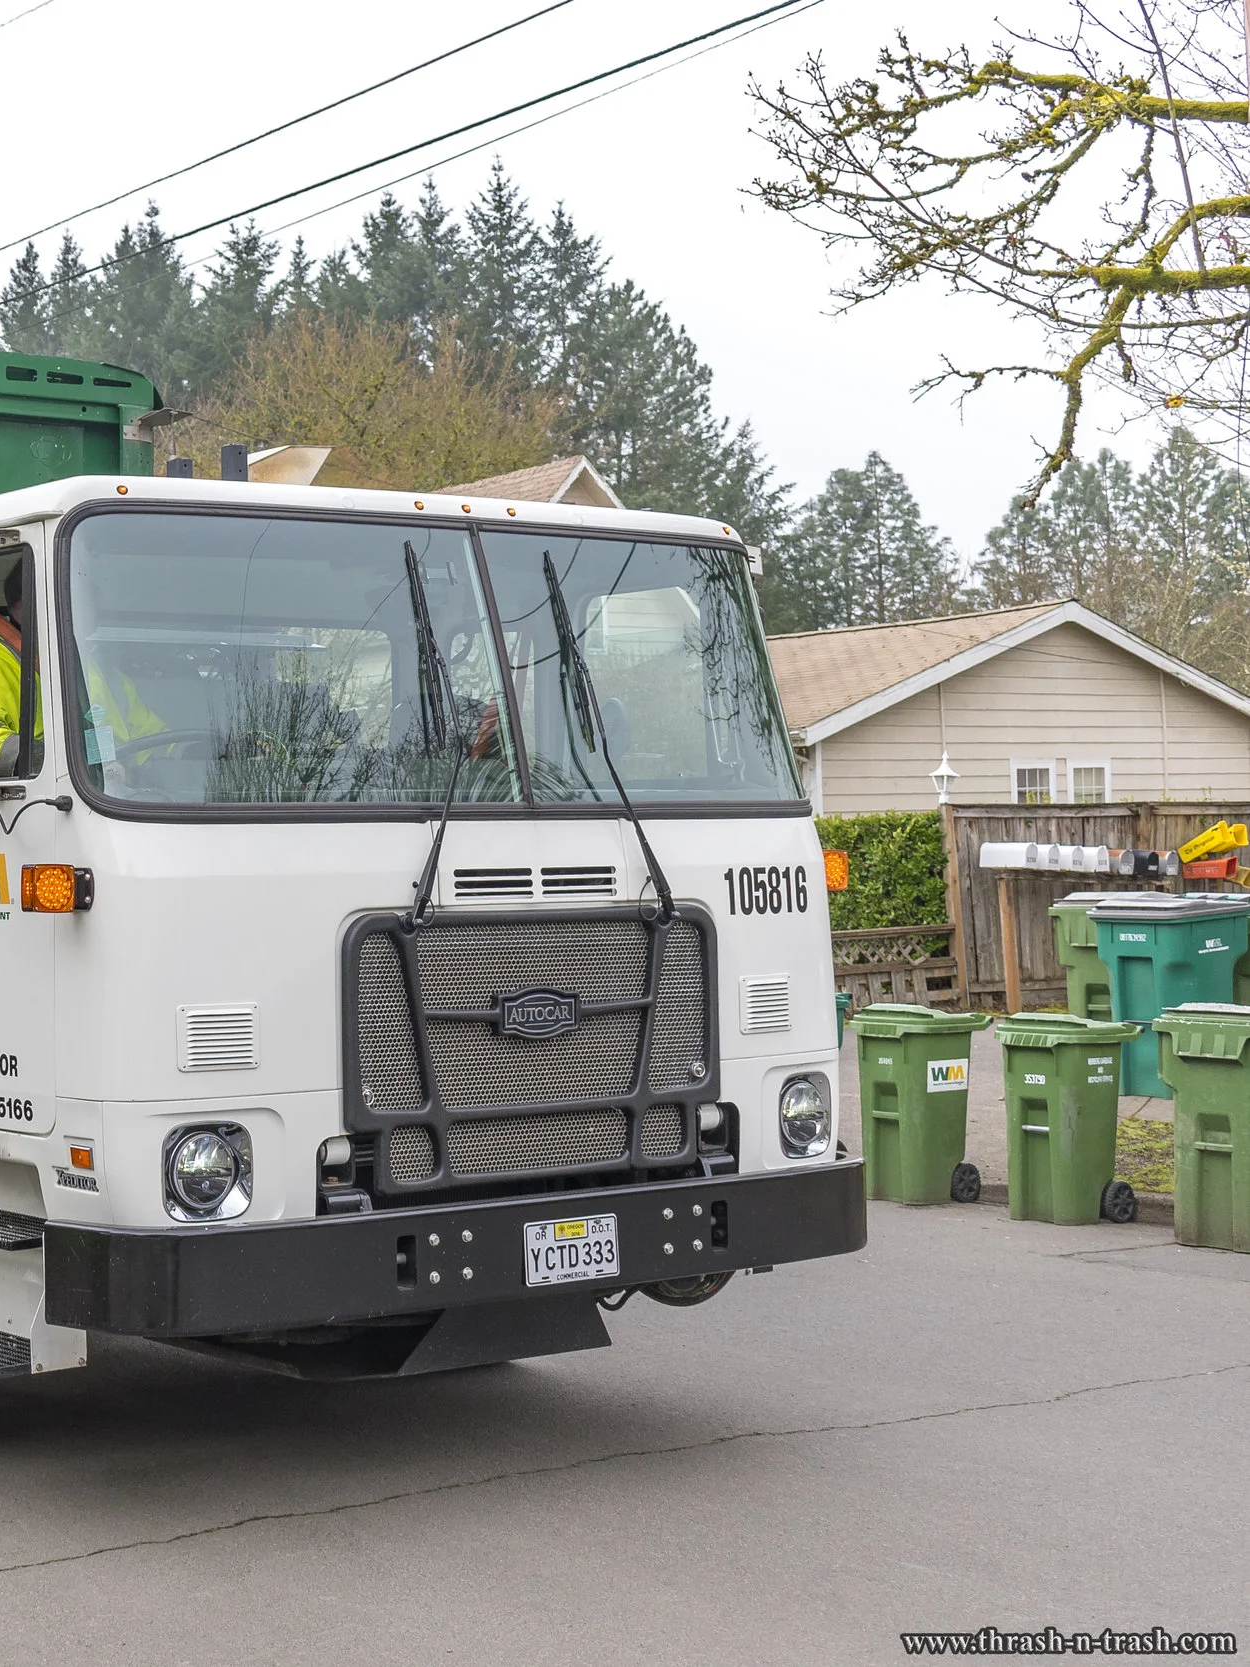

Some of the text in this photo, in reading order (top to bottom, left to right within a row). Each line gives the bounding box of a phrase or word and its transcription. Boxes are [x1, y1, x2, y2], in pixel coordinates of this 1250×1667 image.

[724, 865, 808, 915] 105816
[508, 1005, 571, 1022] AUTOCAR
[0, 1053, 18, 1077] OR
[931, 1065, 965, 1081] WM
[1024, 1073, 1046, 1085] 353790
[535, 1231, 547, 1241] OR
[591, 1223, 613, 1234] D.O.T.
[556, 1271, 590, 1280] COMMERCIAL
